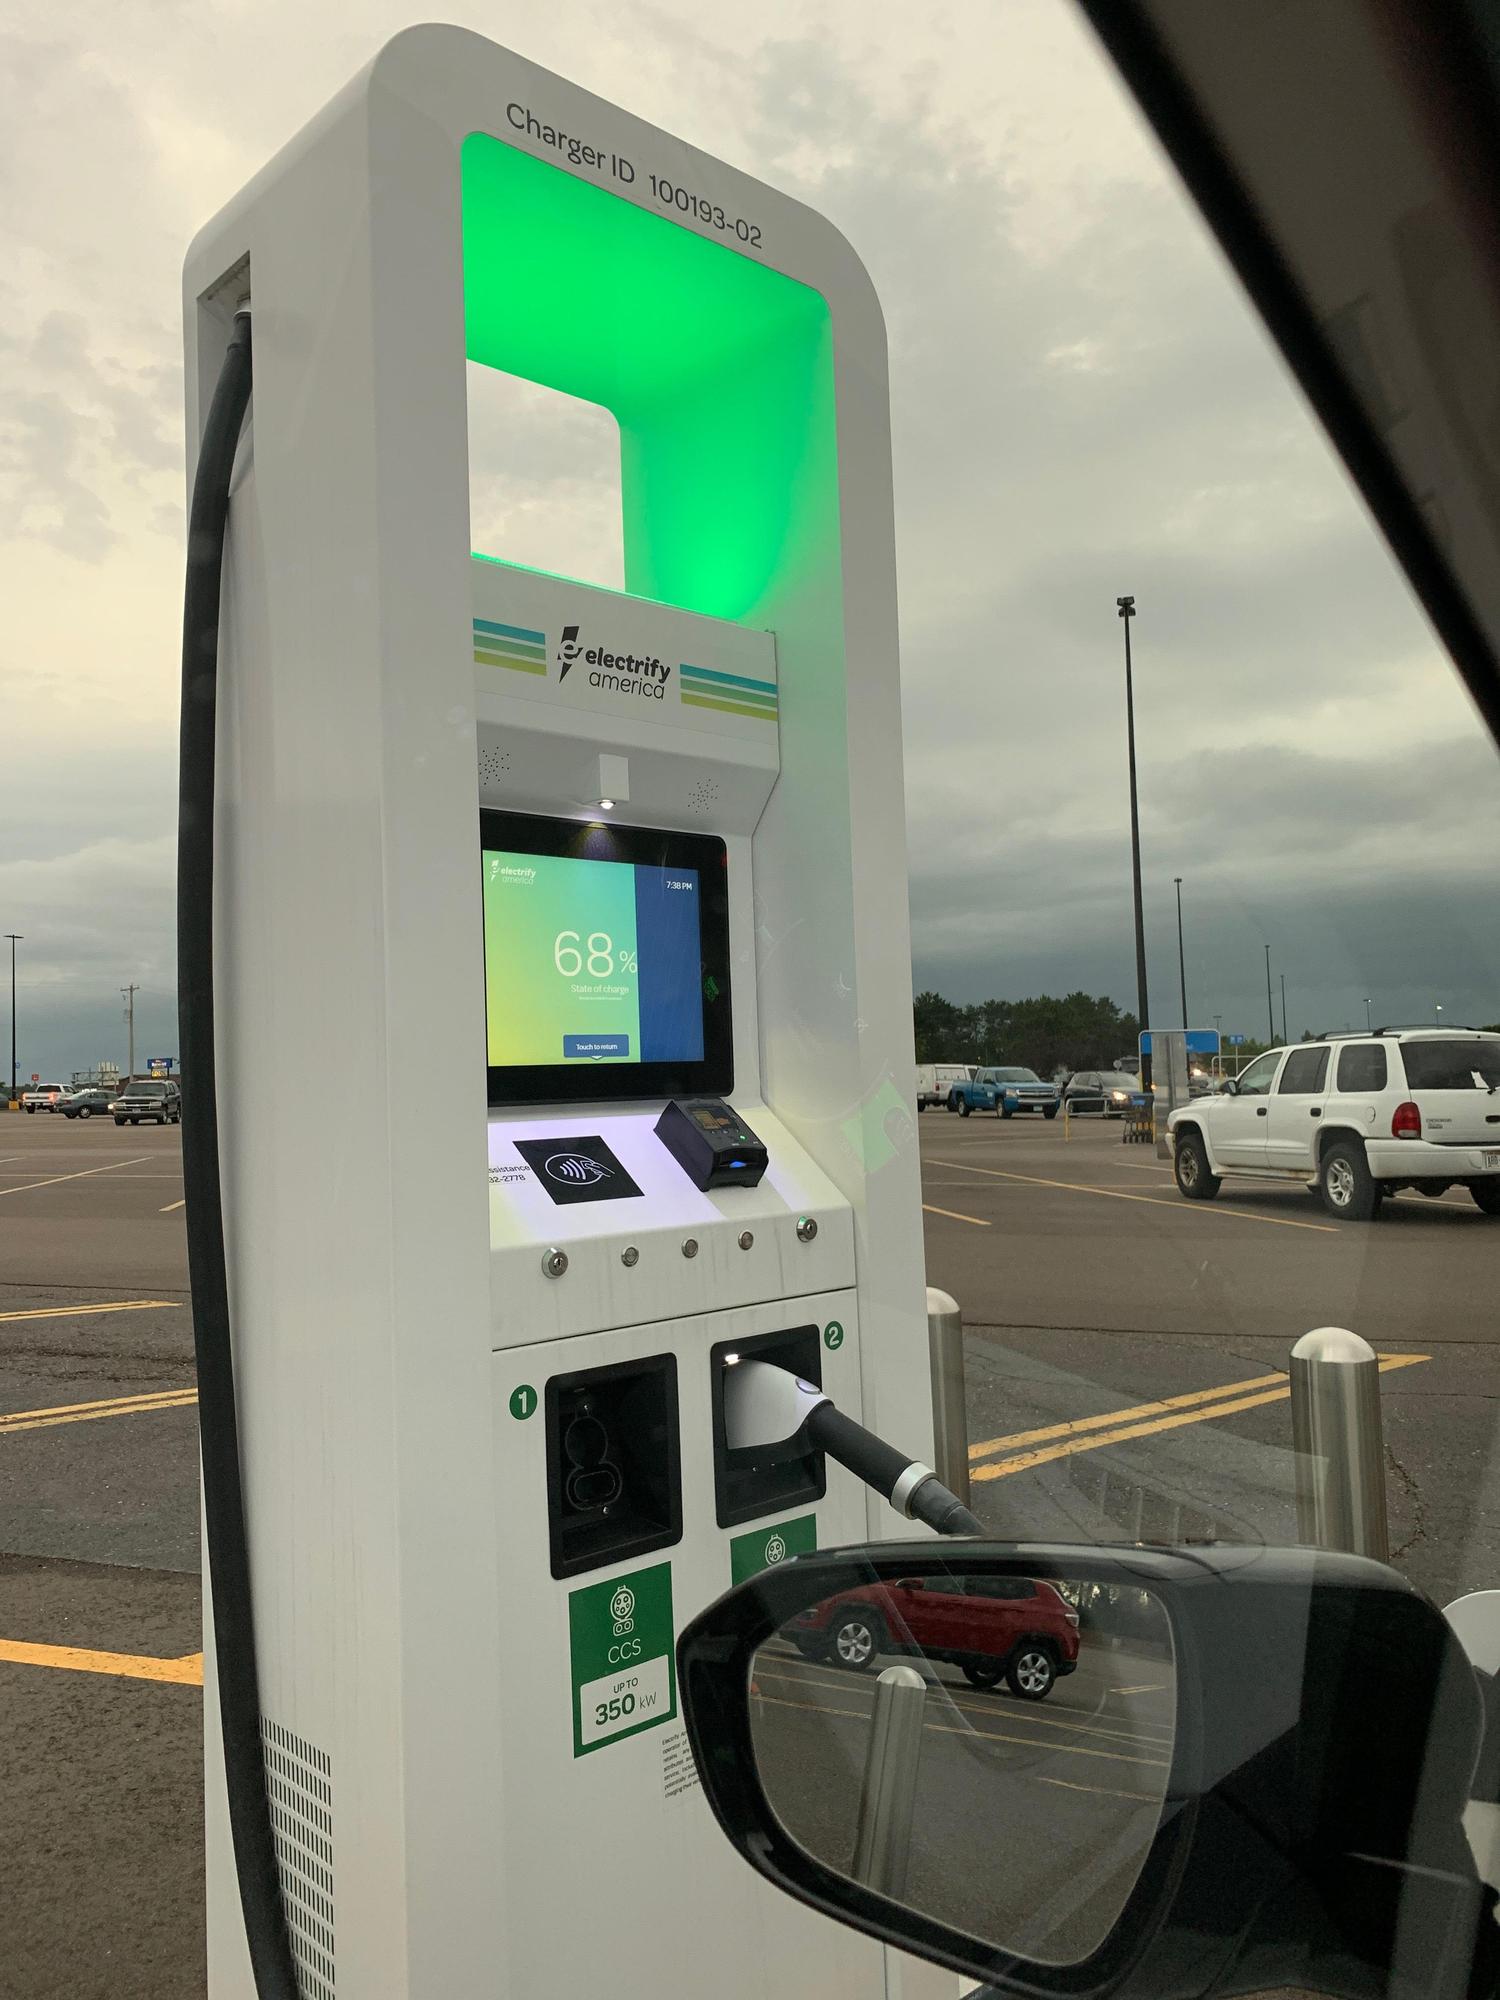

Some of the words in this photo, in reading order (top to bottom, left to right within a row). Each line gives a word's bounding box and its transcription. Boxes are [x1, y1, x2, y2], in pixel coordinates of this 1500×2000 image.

[506, 103, 606, 169] Charger
[612, 154, 635, 184] ID
[649, 174, 763, 249] 100193-02
[585, 647, 671, 684] electrify
[589, 671, 665, 700] america
[666, 881, 681, 890] 7:38
[682, 882, 693, 891] PM
[570, 984, 592, 993] State
[593, 984, 602, 993] of
[603, 985, 629, 995] charge
[576, 1043, 593, 1051] Touch
[829, 1326, 840, 1346] 2
[518, 1391, 527, 1414] 1
[608, 1638, 641, 1664] CCS
[613, 1682, 625, 1694] UP
[626, 1677, 639, 1689] TO
[595, 1693, 636, 1726] 350
[639, 1691, 657, 1709] kW
